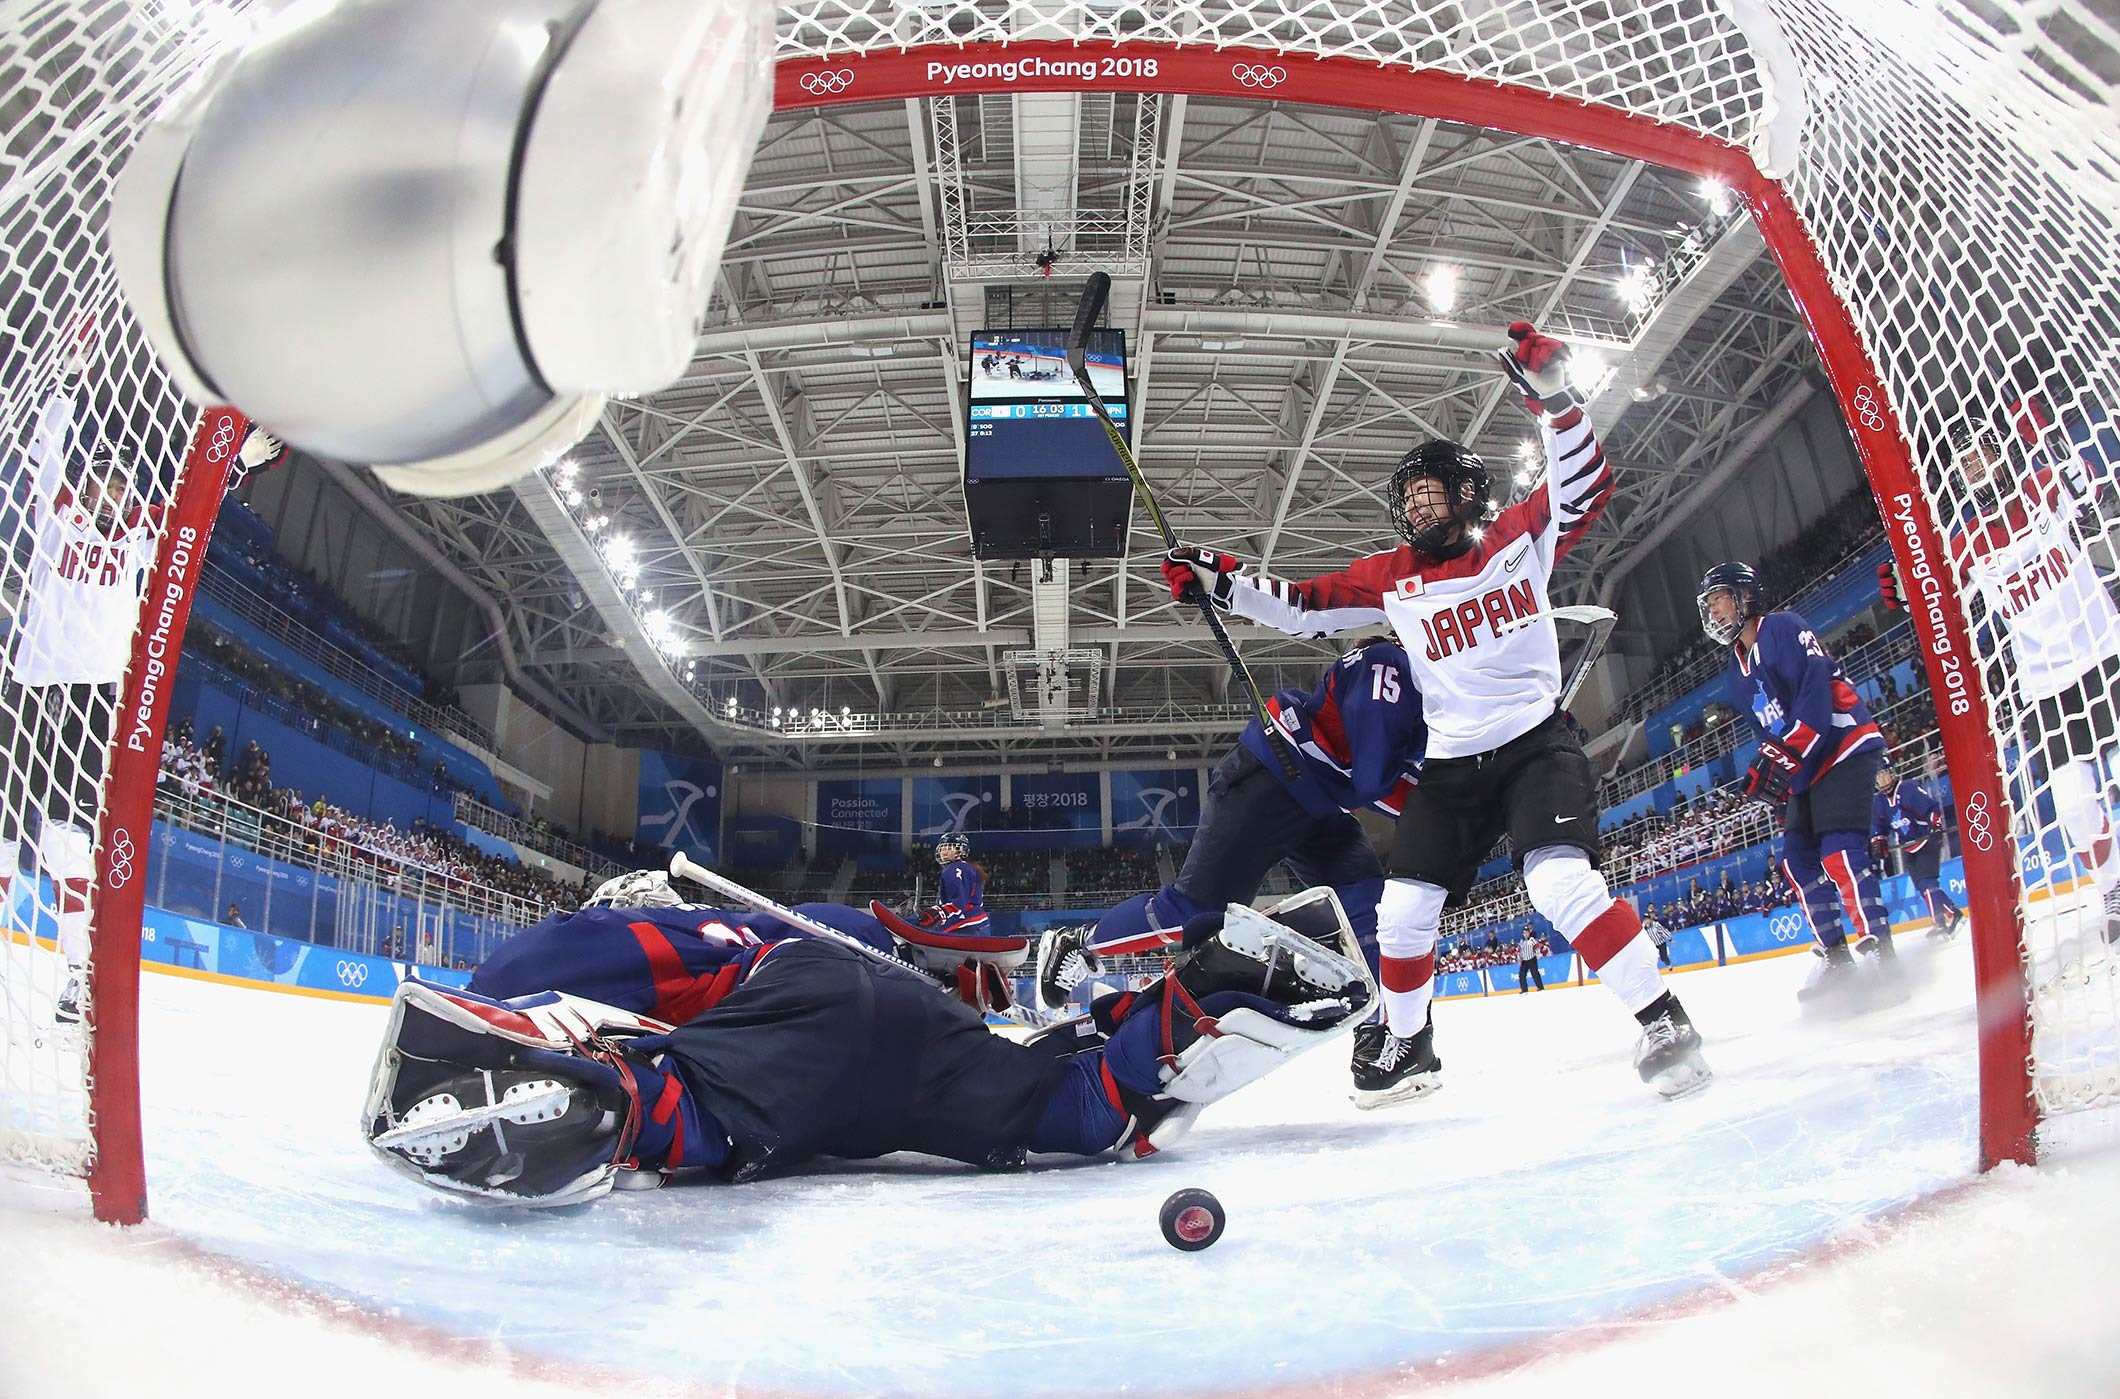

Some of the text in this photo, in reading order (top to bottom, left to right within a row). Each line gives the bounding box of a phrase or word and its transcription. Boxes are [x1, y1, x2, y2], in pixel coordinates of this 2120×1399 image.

[927, 57, 1159, 84] PyeongChang 2018
[971, 408, 992, 417] COR
[1015, 405, 1026, 418] 0
[1071, 405, 1082, 418] 1
[1893, 493, 1970, 716] PyeongChang 2018
[1421, 578, 1539, 662] JAPAN
[127, 526, 197, 753] PyeongChang 2018
[1371, 663, 1401, 704] 15
[1758, 742, 1796, 771] CM
[831, 797, 879, 808] Passion.
[831, 807, 889, 819] Connected
[2023, 850, 2052, 872] 208
